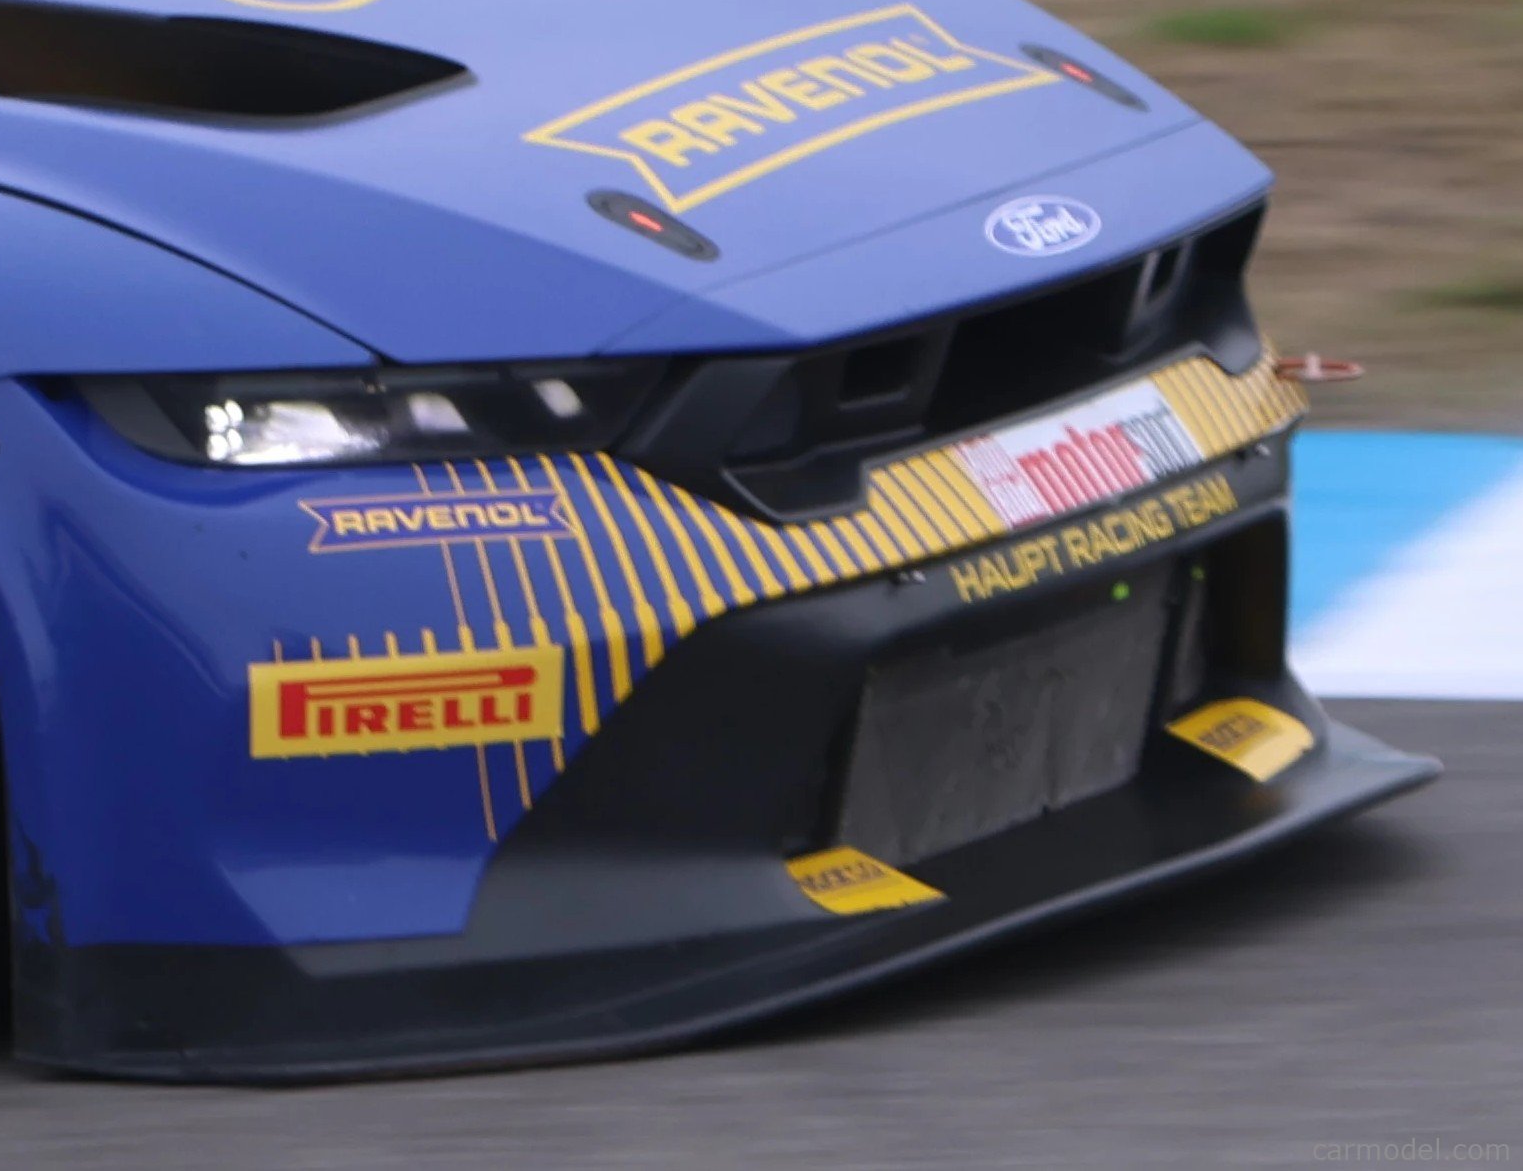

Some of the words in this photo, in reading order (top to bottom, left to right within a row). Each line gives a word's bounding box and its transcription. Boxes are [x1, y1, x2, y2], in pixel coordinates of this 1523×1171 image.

[1002, 204, 1089, 250] Ford
[333, 501, 529, 535] RAVENOL
[949, 534, 1064, 603] HAUPT
[1061, 499, 1175, 568] RACING
[1162, 472, 1238, 530] TEAM
[278, 665, 537, 739] PIRELLI
